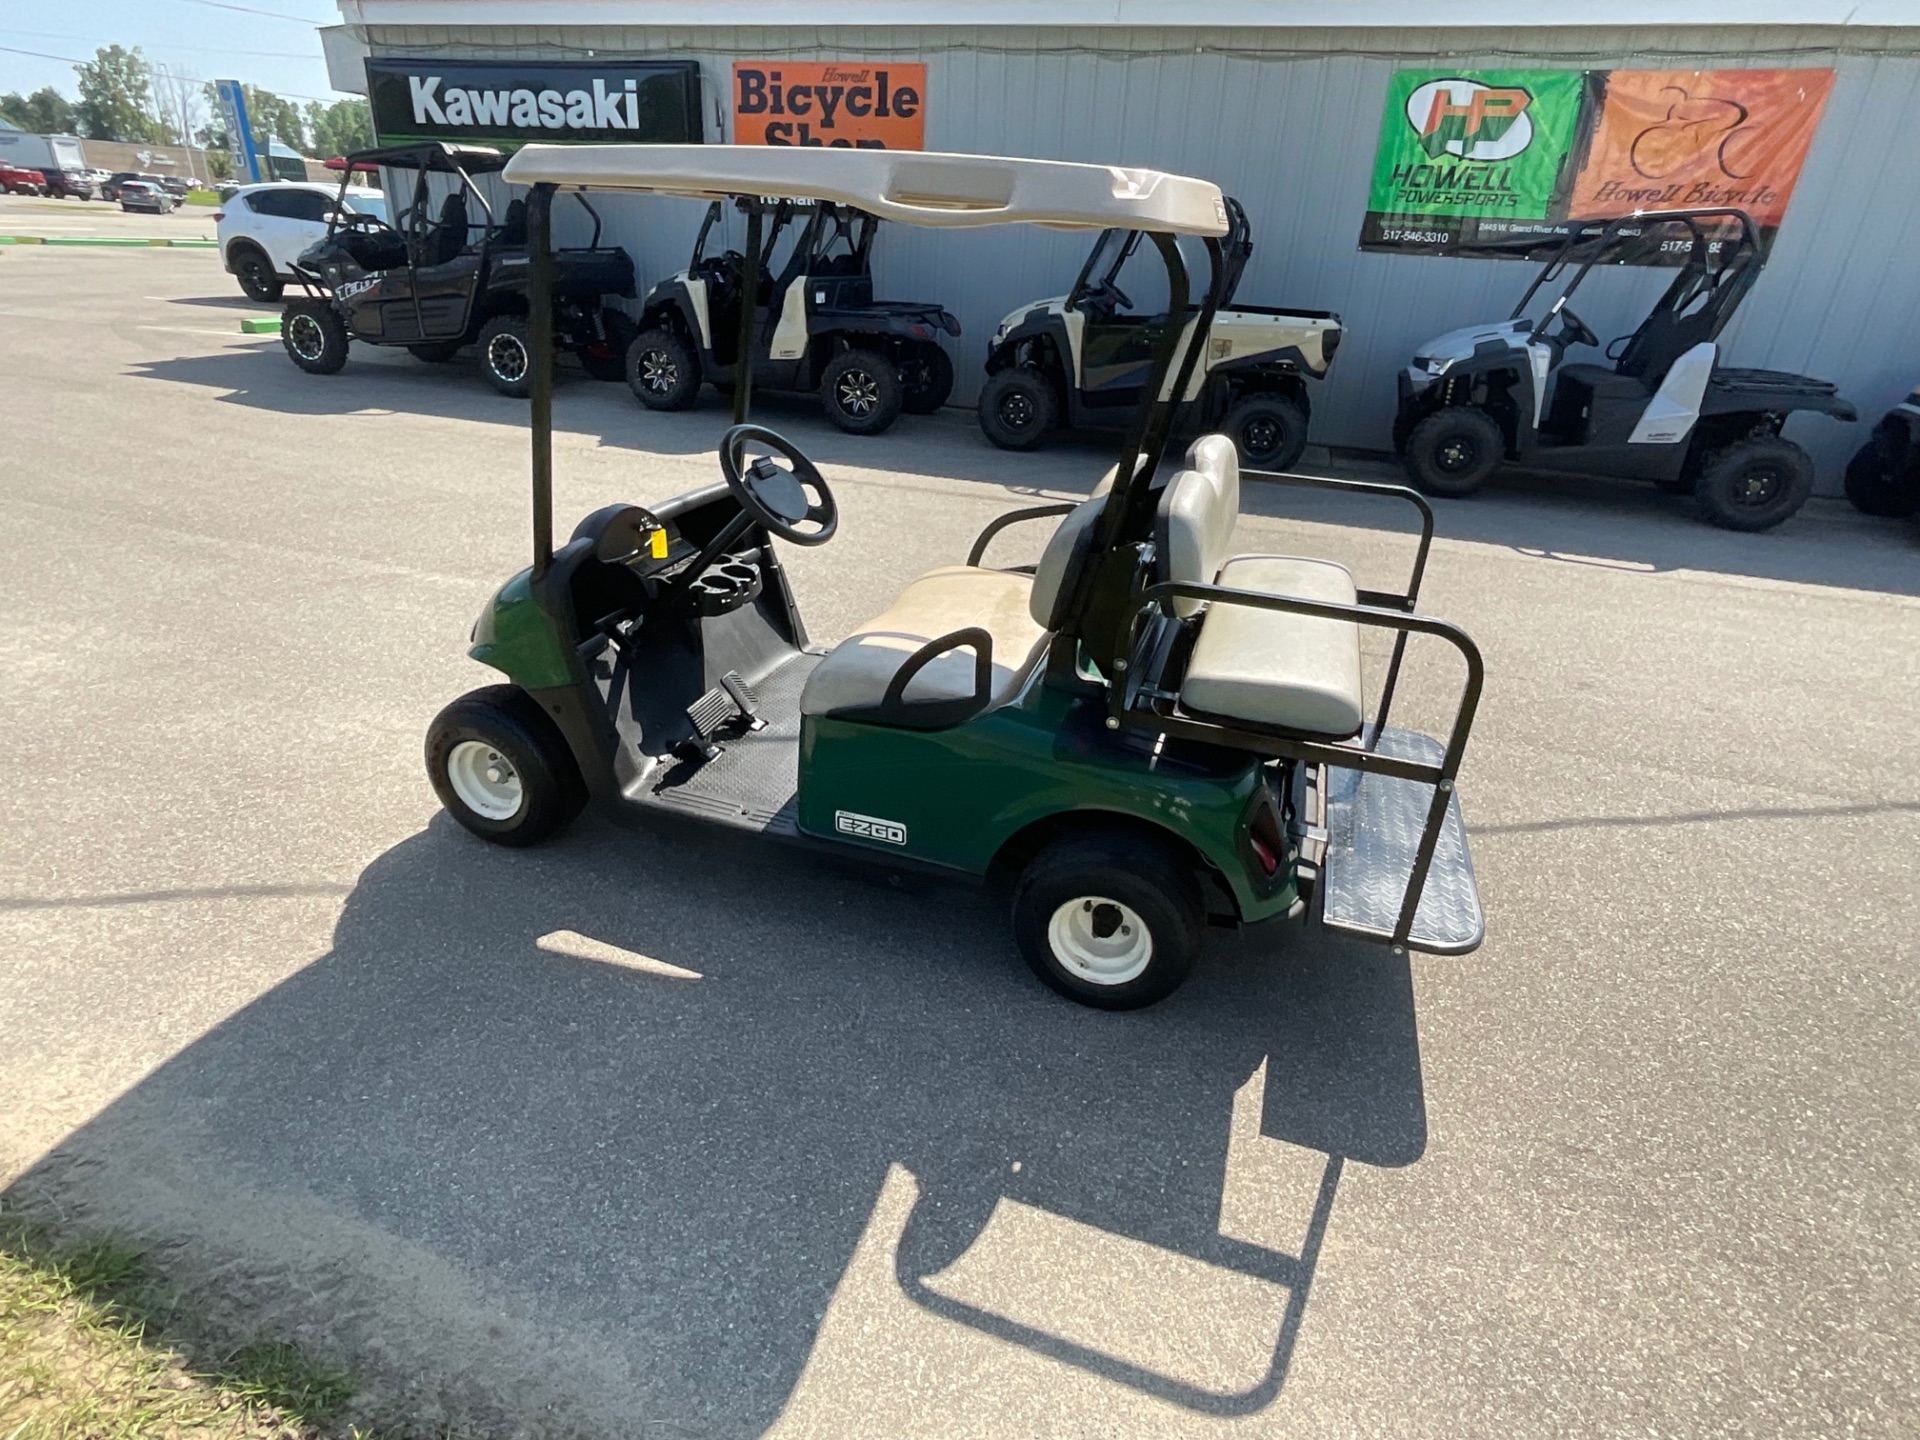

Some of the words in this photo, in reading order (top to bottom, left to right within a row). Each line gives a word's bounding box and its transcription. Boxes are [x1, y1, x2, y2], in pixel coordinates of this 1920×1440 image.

[822, 67, 870, 83] Howell
[409, 76, 640, 129] Kawasaki
[737, 69, 919, 129] Bicycle
[224, 104, 245, 167] CHASE
[765, 121, 886, 149] Sh
[1388, 164, 1512, 191] HOWELL
[1394, 190, 1521, 207] POWERSPORTS
[1592, 180, 1682, 203] Howell
[1383, 229, 1449, 243] 517-546-3310
[1509, 224, 1532, 233] Grand
[1533, 225, 1553, 234] River
[839, 817, 904, 842] EZGO
